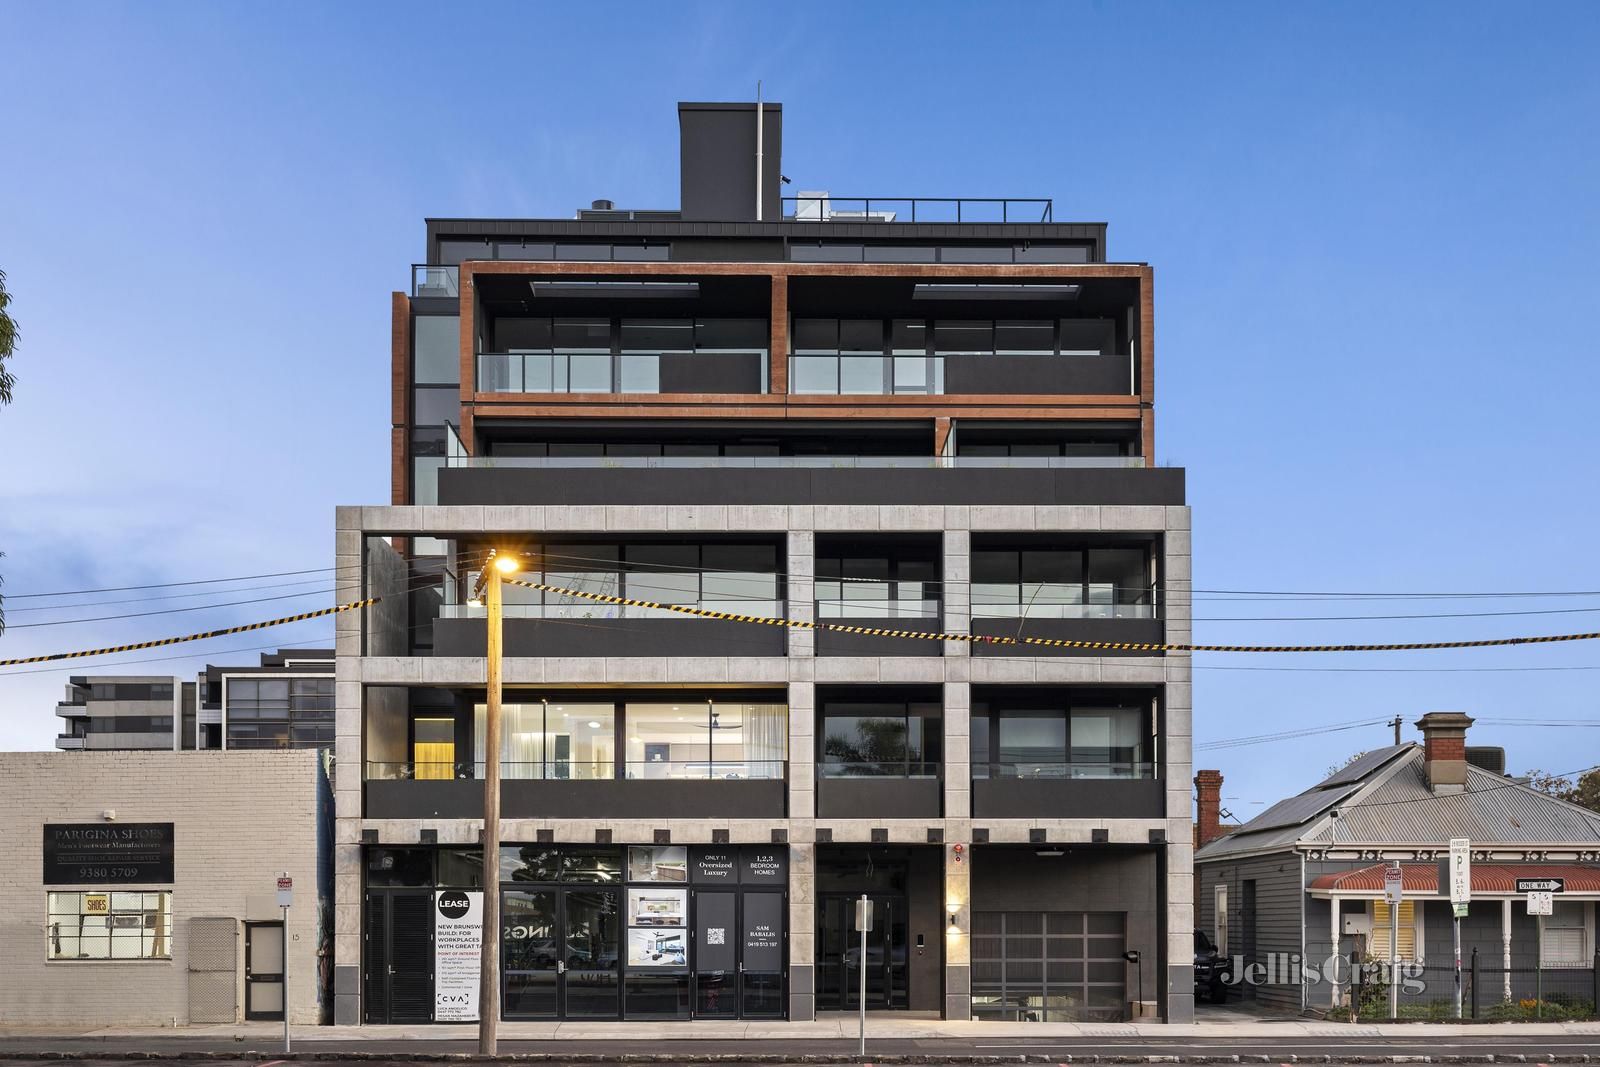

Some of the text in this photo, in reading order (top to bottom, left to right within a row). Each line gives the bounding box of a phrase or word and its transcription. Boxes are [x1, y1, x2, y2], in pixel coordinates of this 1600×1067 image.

[55, 829, 163, 840] PARIGINA SHOES
[80, 868, 138, 878] 9380 5709
[87, 899, 107, 911] SHOES
[439, 900, 469, 908] LEASE
